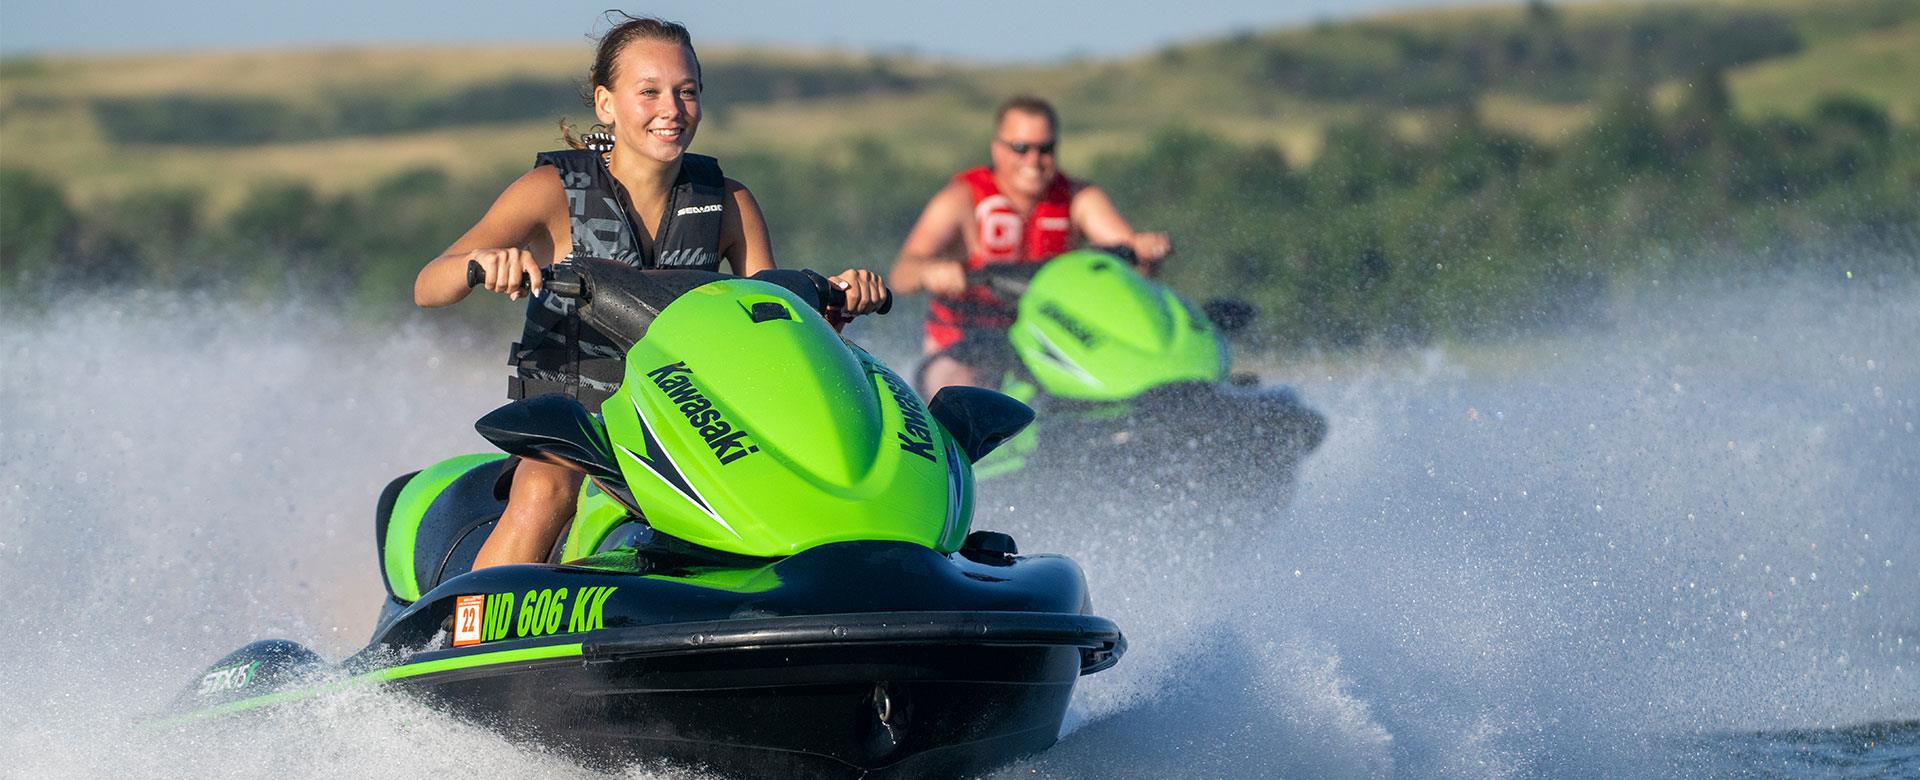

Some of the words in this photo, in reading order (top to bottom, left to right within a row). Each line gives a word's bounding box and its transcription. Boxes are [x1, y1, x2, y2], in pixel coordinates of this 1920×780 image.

[646, 360, 760, 466] Kawasaki
[461, 607, 476, 633] 22
[480, 592, 515, 642] ND
[516, 587, 569, 638] 606
[567, 586, 619, 633] KK
